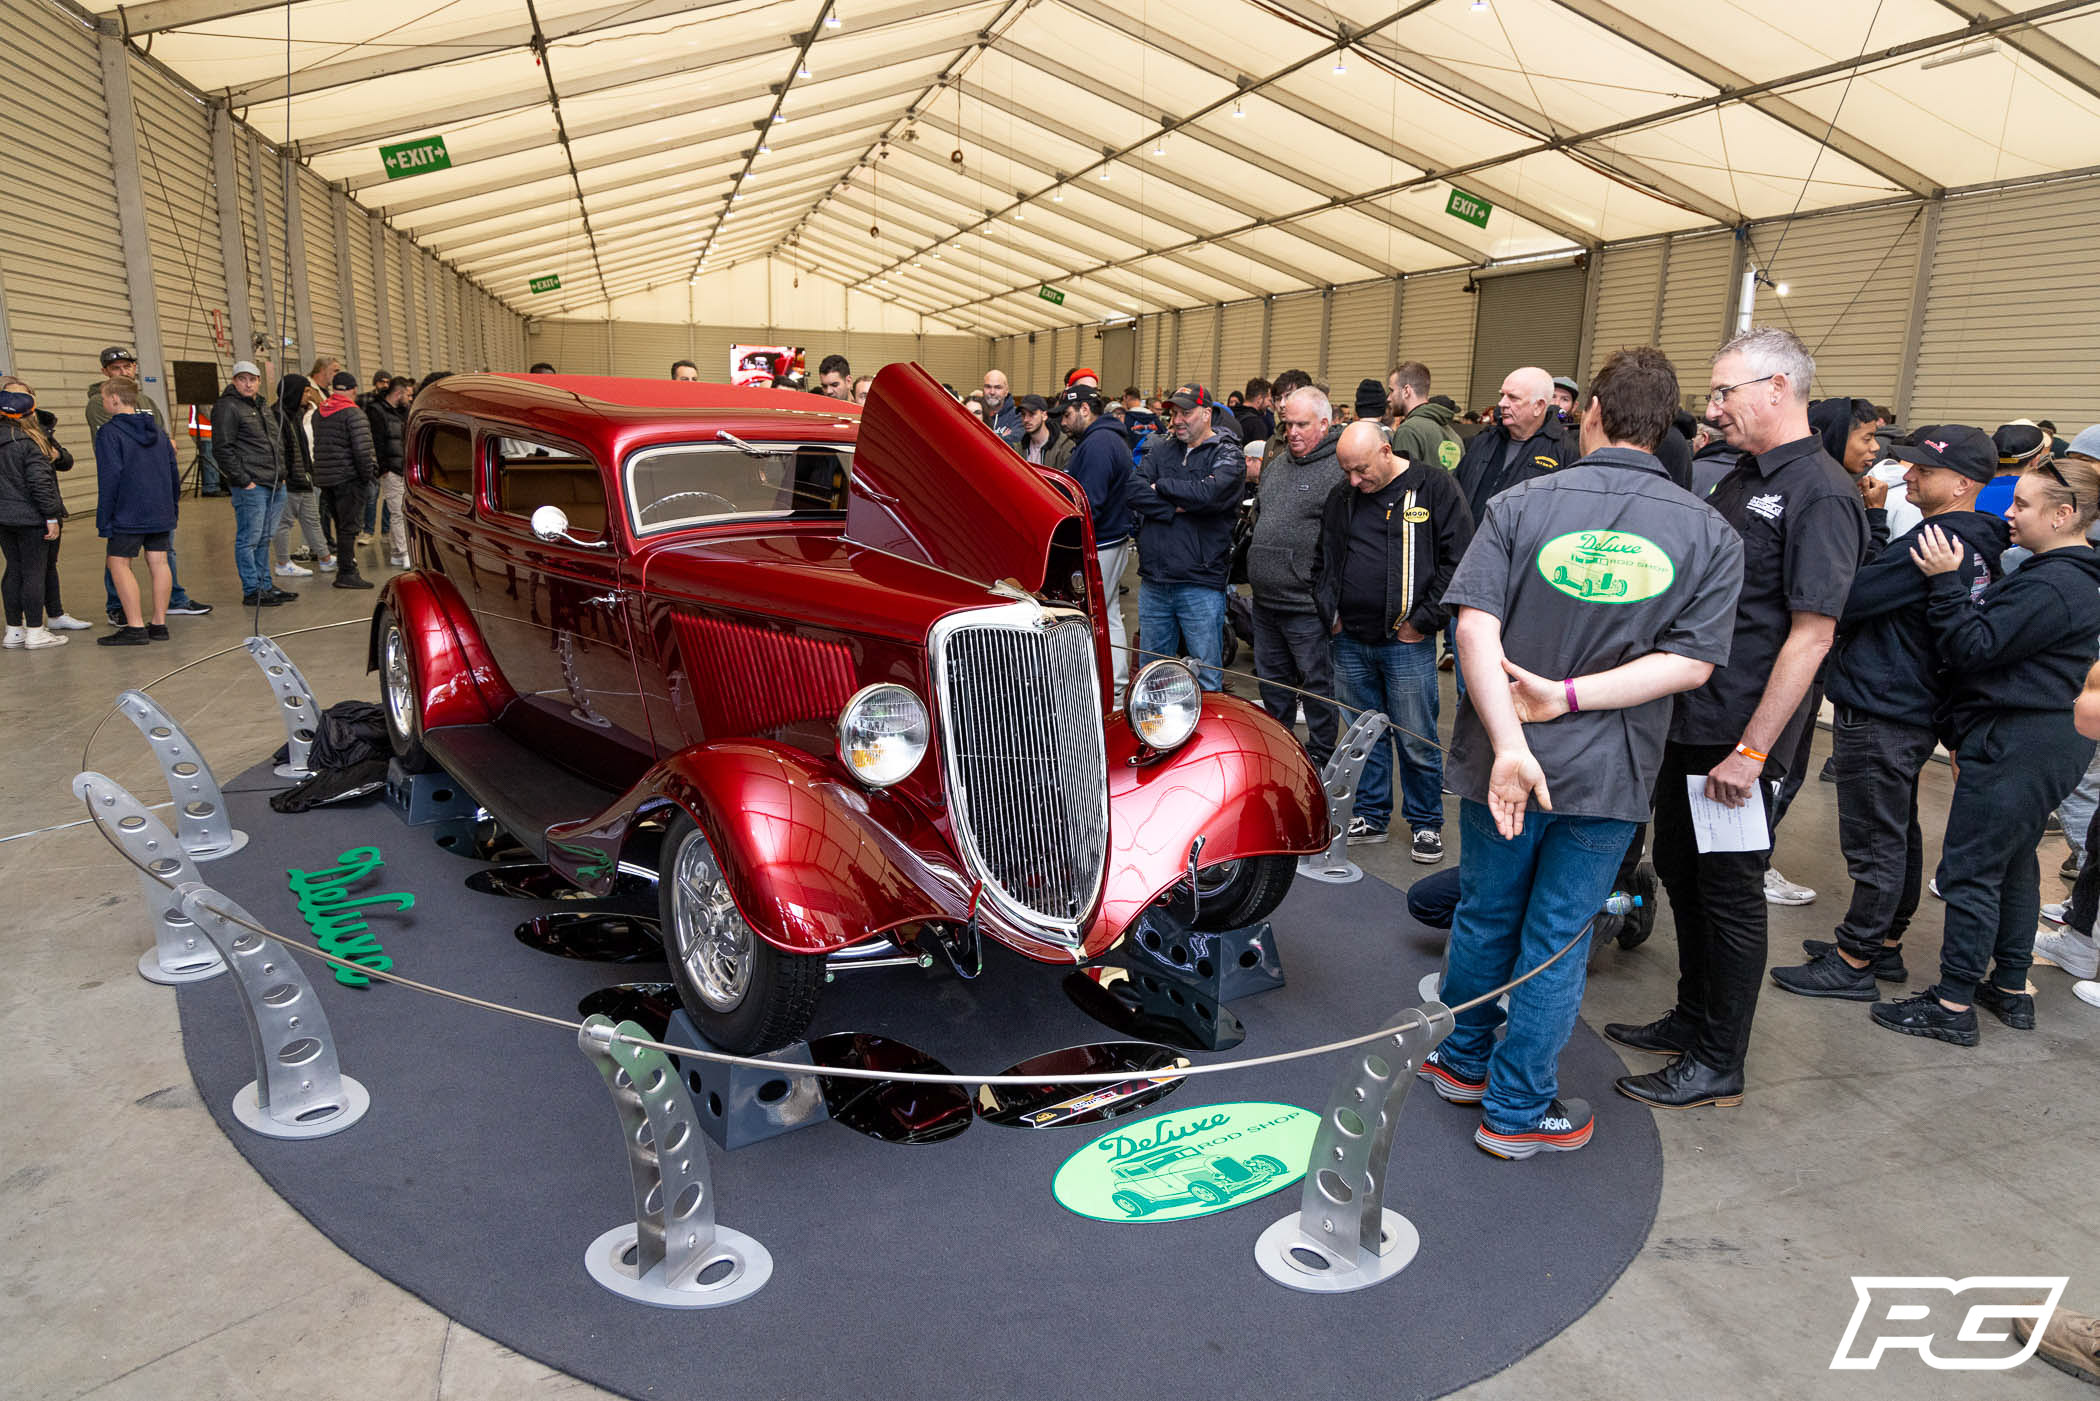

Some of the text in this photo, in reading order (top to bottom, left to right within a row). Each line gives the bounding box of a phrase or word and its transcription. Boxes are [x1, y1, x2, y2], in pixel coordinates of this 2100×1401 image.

[396, 145, 436, 169] EXIT
[1451, 195, 1479, 217] EXIT
[536, 278, 556, 291] EXIT
[1199, 1111, 1301, 1151] ROD SHOP
[1539, 1117, 1572, 1131] HOKA
